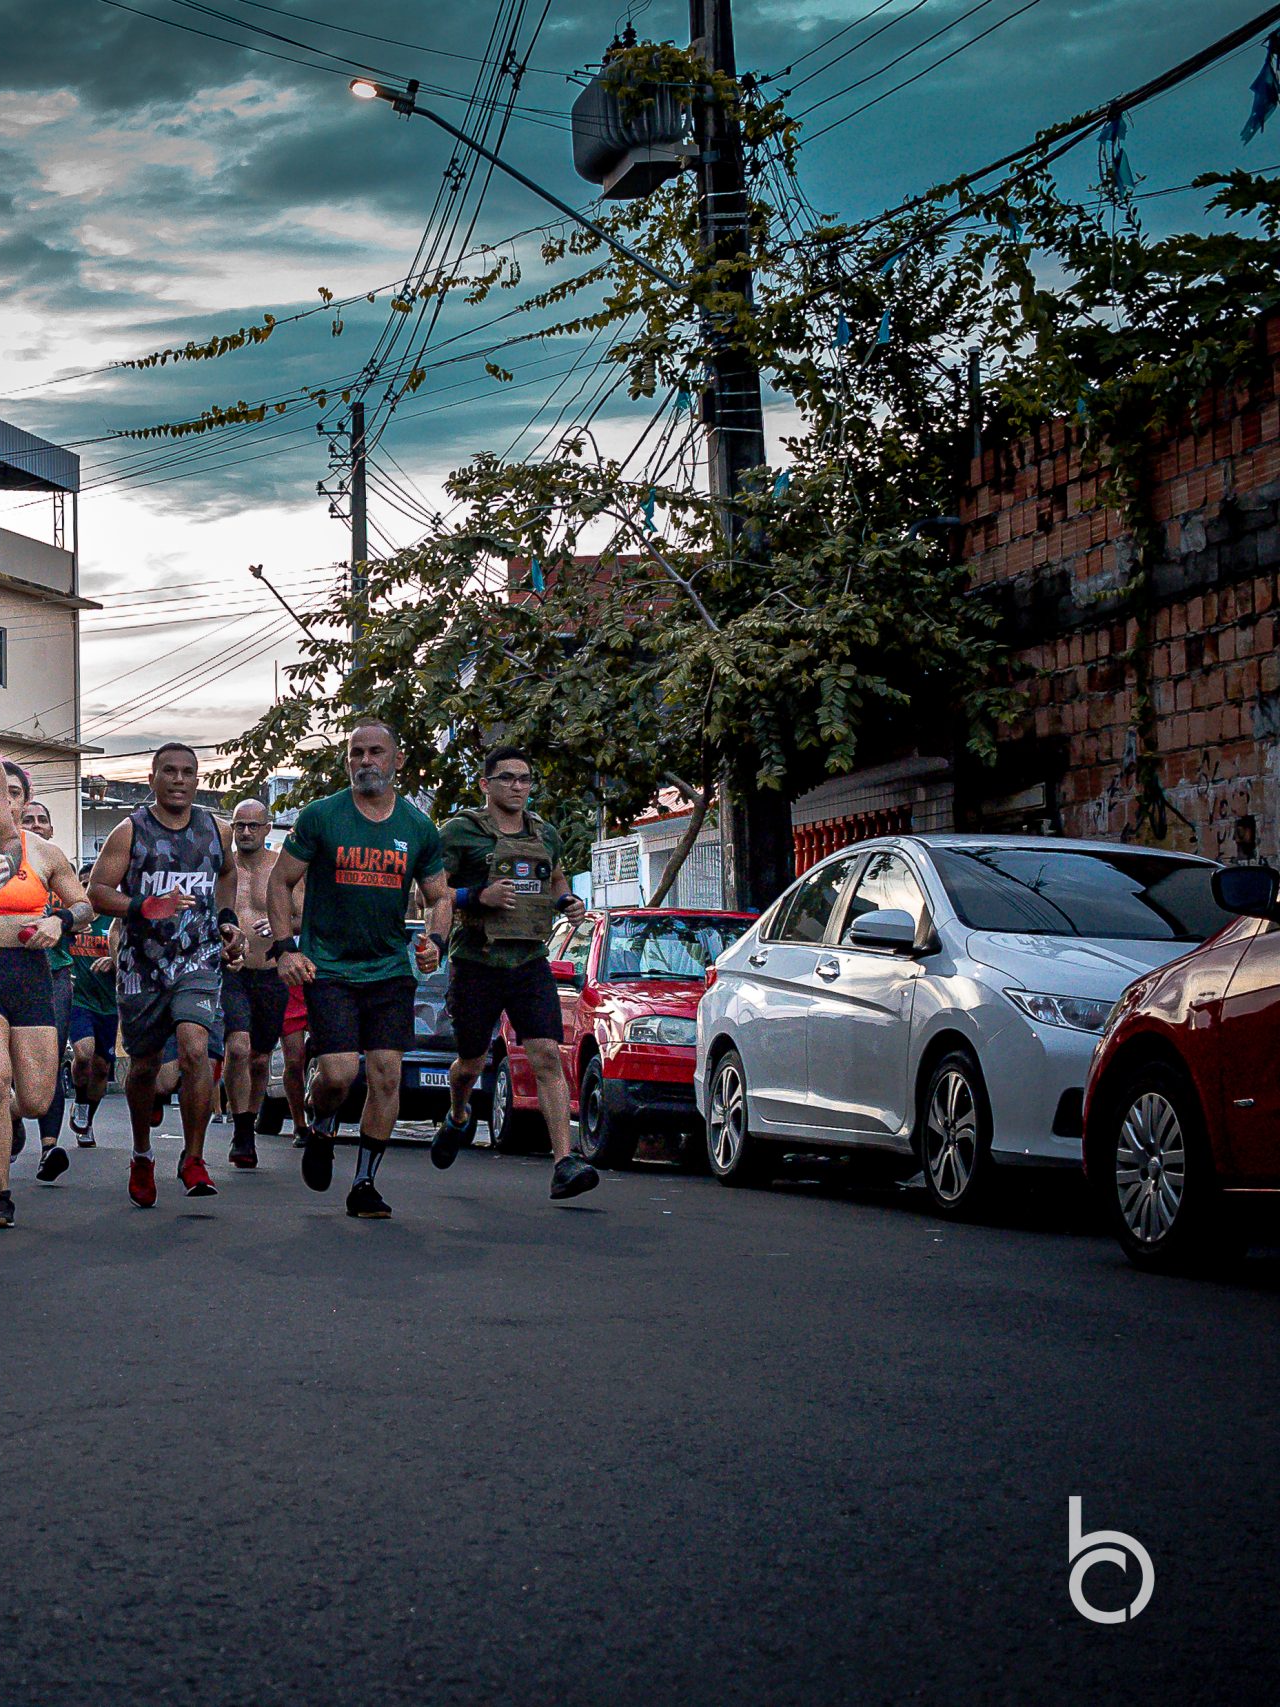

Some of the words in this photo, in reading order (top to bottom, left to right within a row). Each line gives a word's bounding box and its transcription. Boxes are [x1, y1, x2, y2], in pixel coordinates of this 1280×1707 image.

[336, 846, 407, 873] MURPH
[140, 871, 217, 896] MURPH
[425, 1073, 450, 1085] QUA
